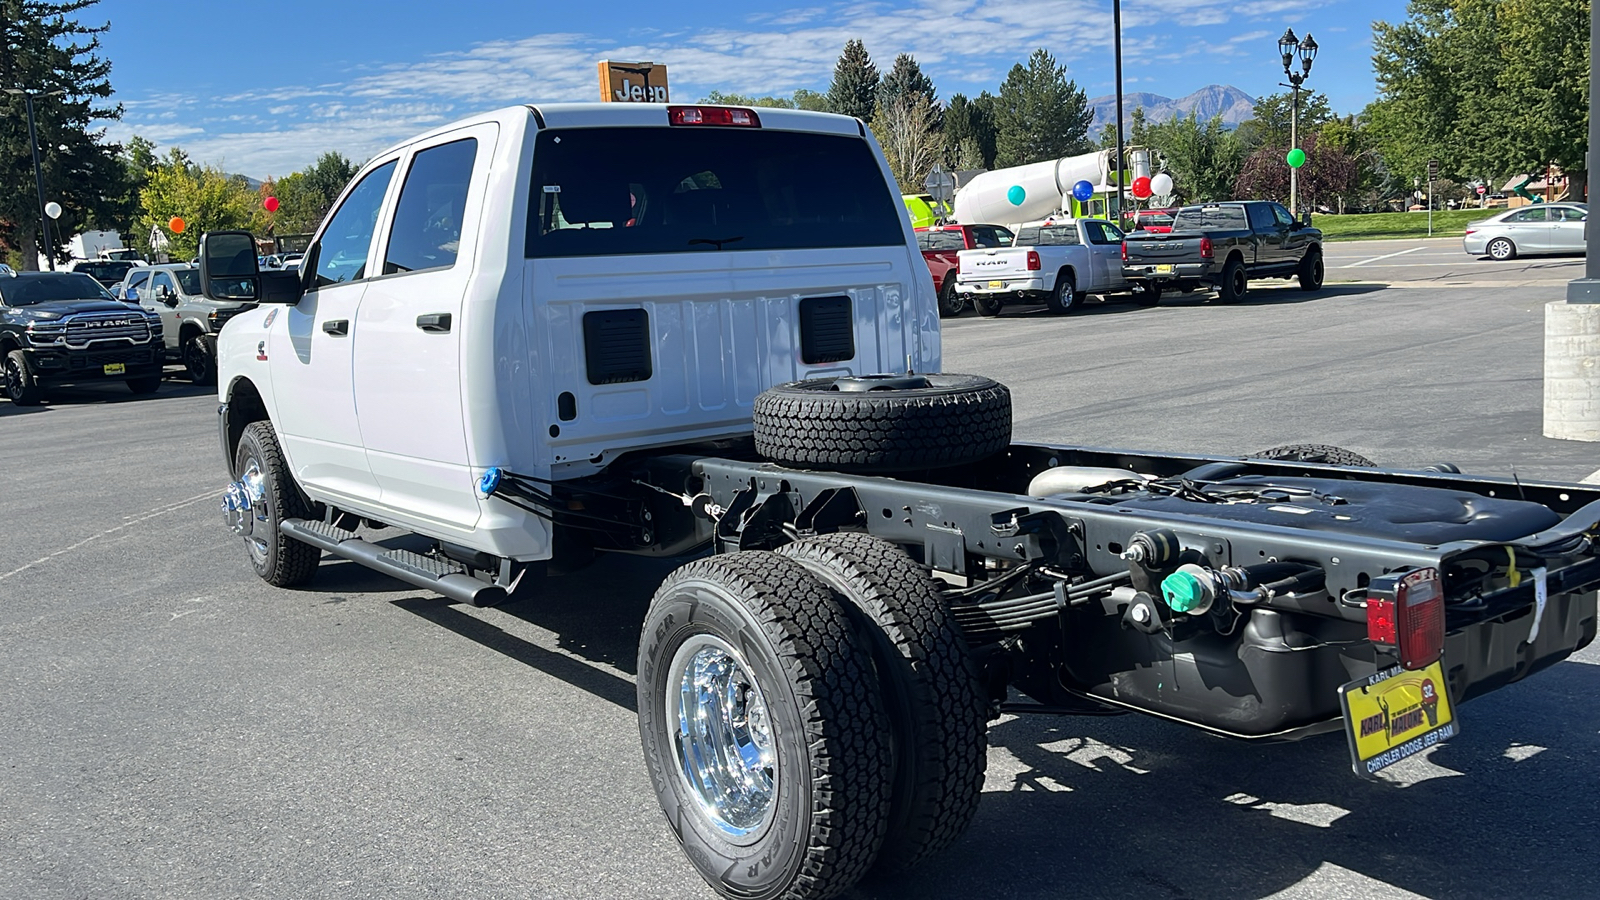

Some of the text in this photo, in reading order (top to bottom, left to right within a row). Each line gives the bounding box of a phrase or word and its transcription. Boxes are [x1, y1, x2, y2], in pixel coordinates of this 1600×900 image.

[88, 319, 128, 328] RAM
[1368, 671, 1390, 685] KARL
[1423, 684, 1434, 698] 32
[1360, 712, 1386, 739] KARL
[1367, 724, 1453, 773] CHRYSLER DODGE JEEP RAM
